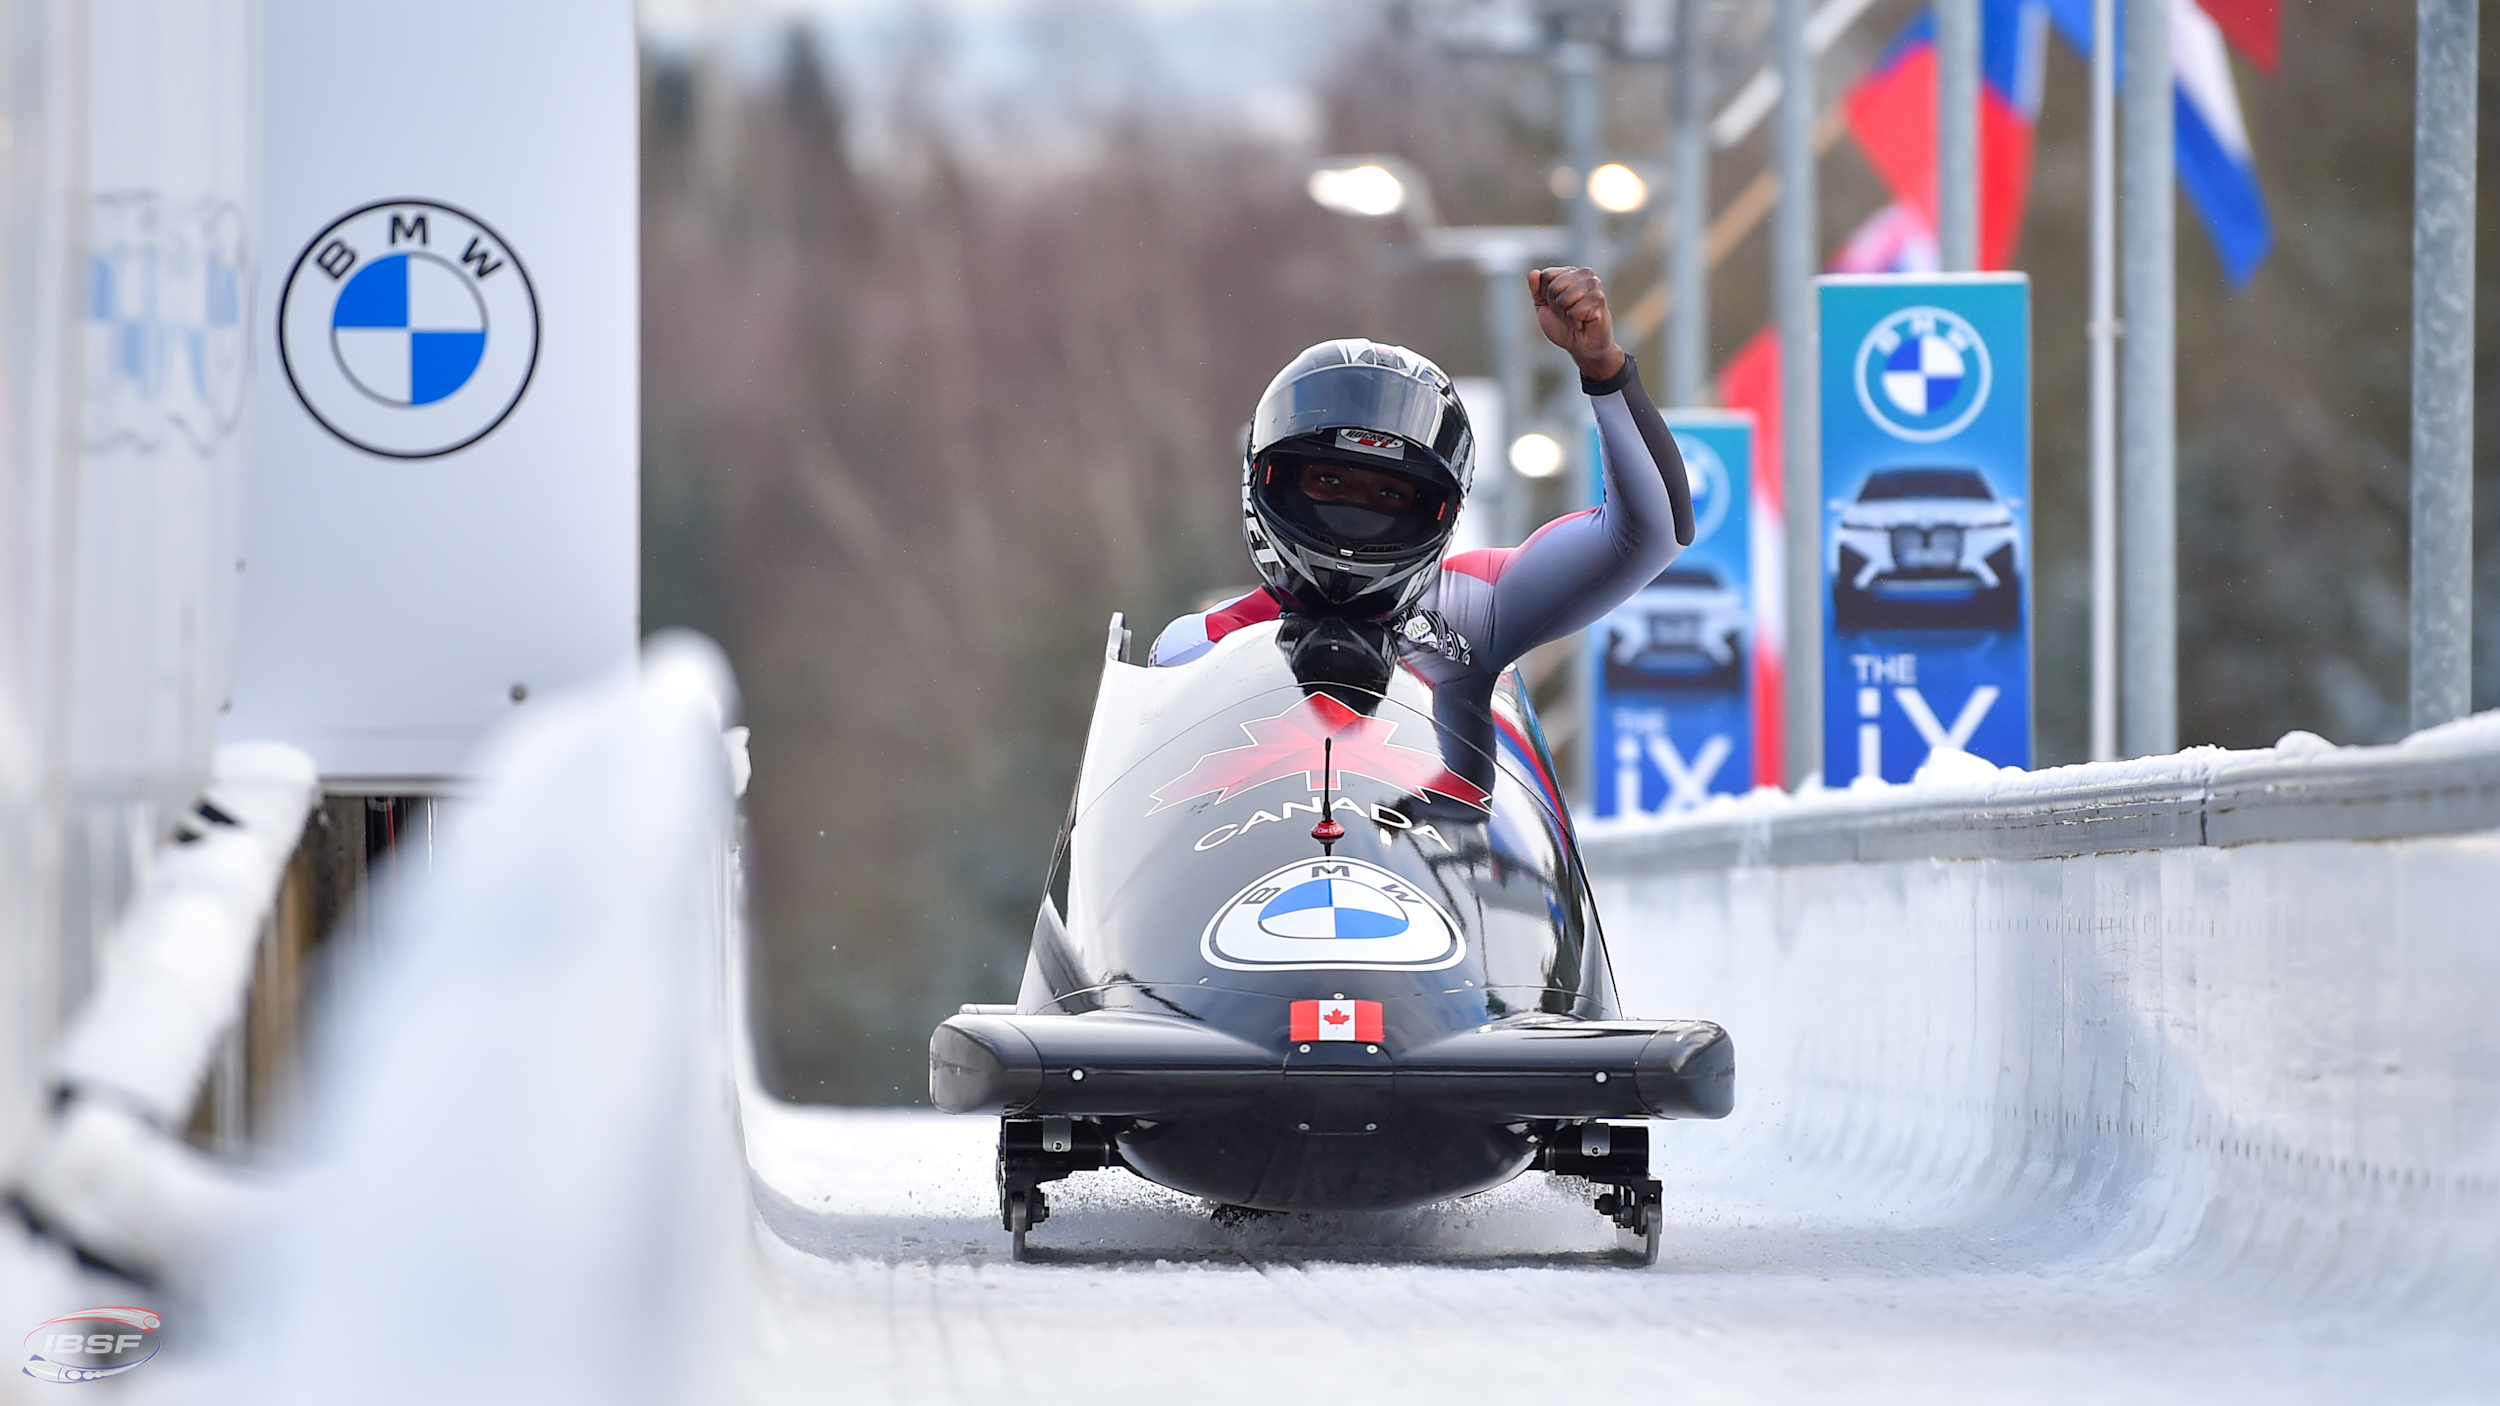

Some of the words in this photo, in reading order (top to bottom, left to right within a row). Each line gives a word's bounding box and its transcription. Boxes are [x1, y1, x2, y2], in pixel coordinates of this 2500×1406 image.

[317, 213, 503, 280] BMW
[1852, 653, 1918, 684] THE
[1194, 796, 1452, 852] CANADA
[1241, 865, 1424, 905] BMW
